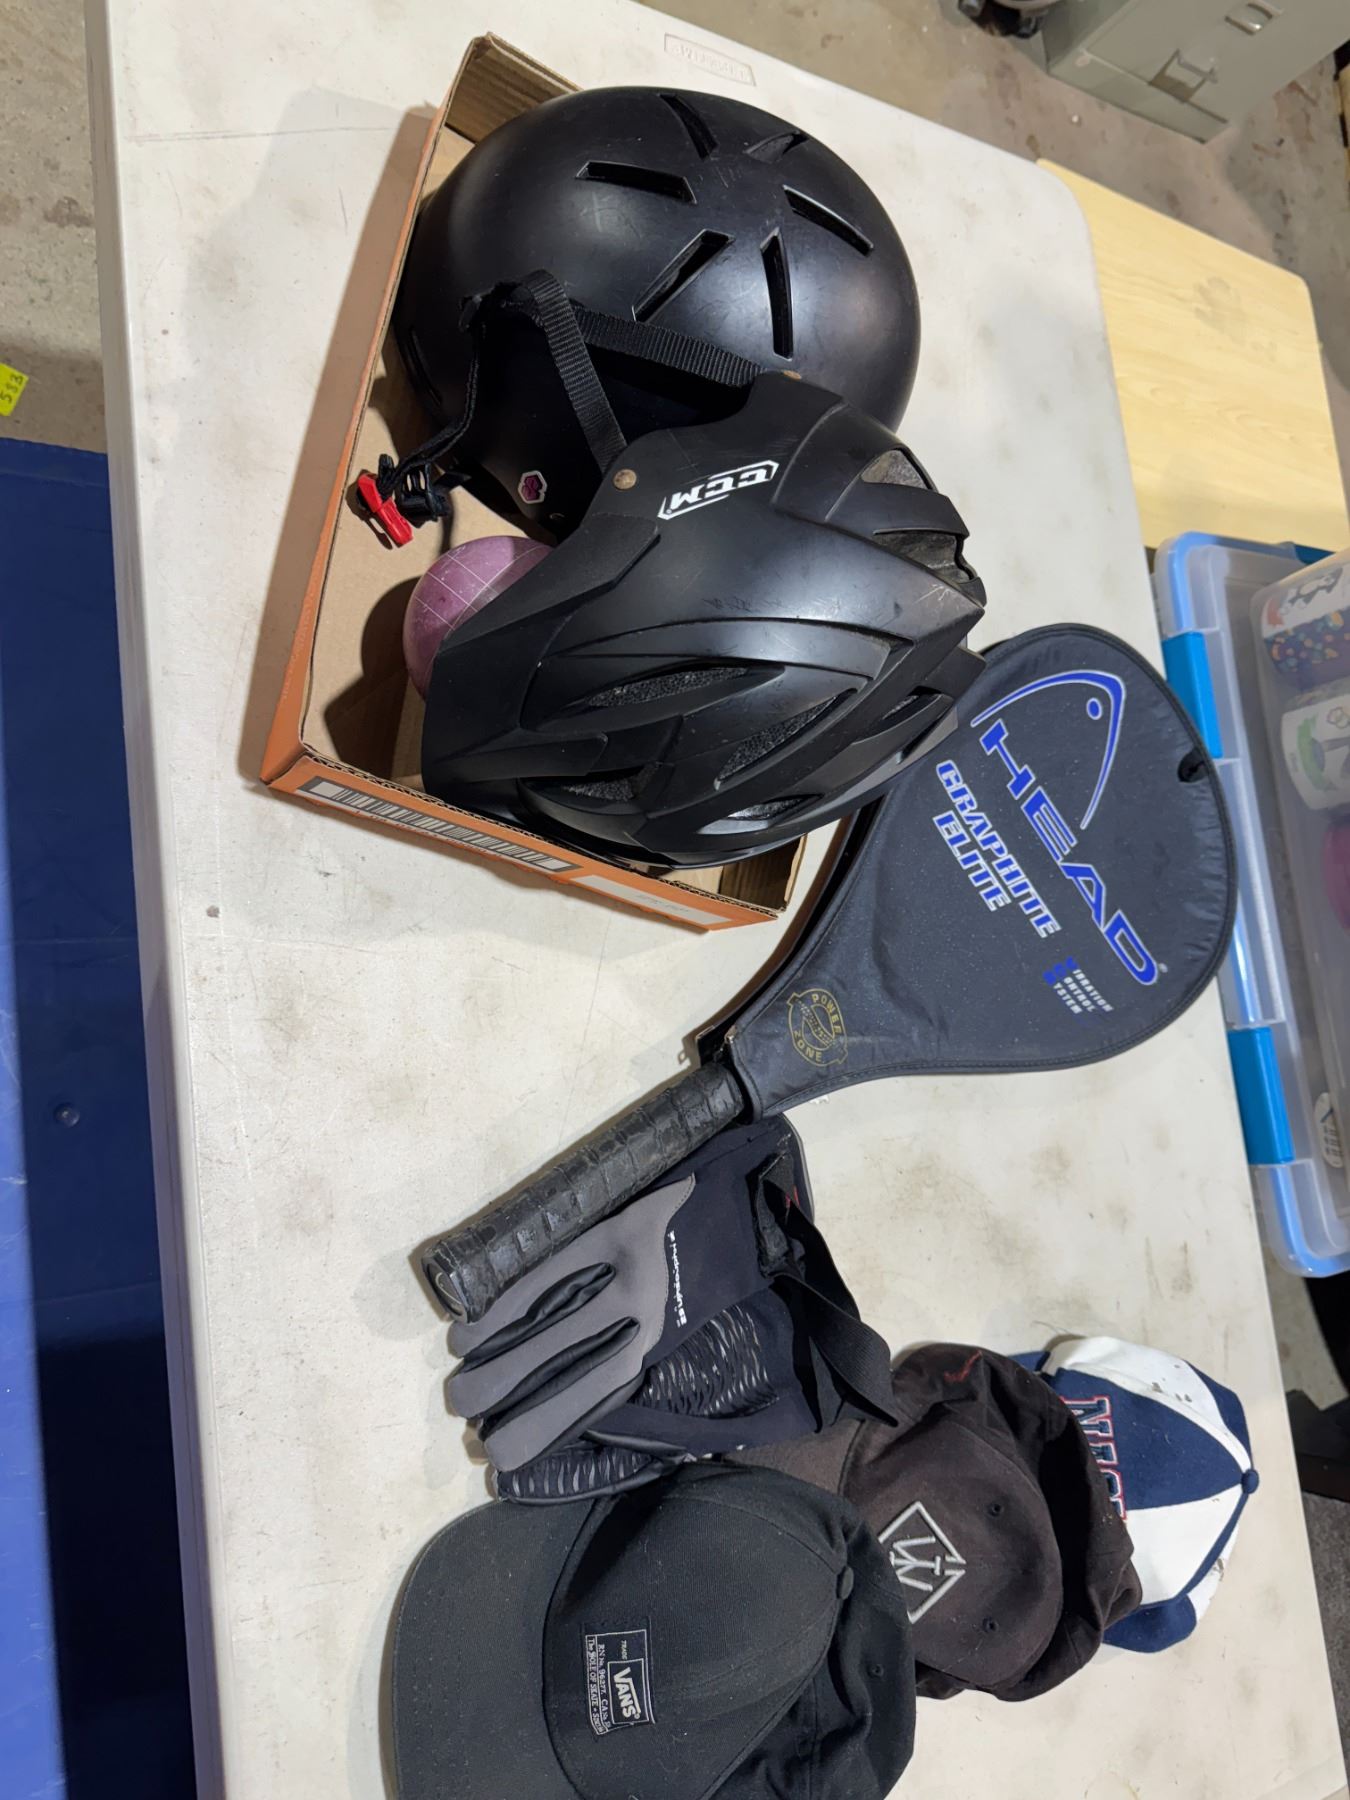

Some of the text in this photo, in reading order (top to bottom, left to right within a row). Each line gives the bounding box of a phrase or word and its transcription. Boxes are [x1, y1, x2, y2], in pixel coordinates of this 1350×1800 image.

[669, 468, 772, 511] CCM
[933, 810, 1012, 911] ELITE
[934, 760, 1062, 938] GRAPHITE
[980, 718, 1158, 985] HEAD
[1042, 969, 1083, 1014] SYSTEM
[1053, 963, 1097, 1013] CONTROL
[1065, 955, 1115, 1012] VIBRATION
[811, 993, 842, 1034] POWER
[793, 1030, 823, 1062] ZONE
[614, 1667, 641, 1717] VANS
